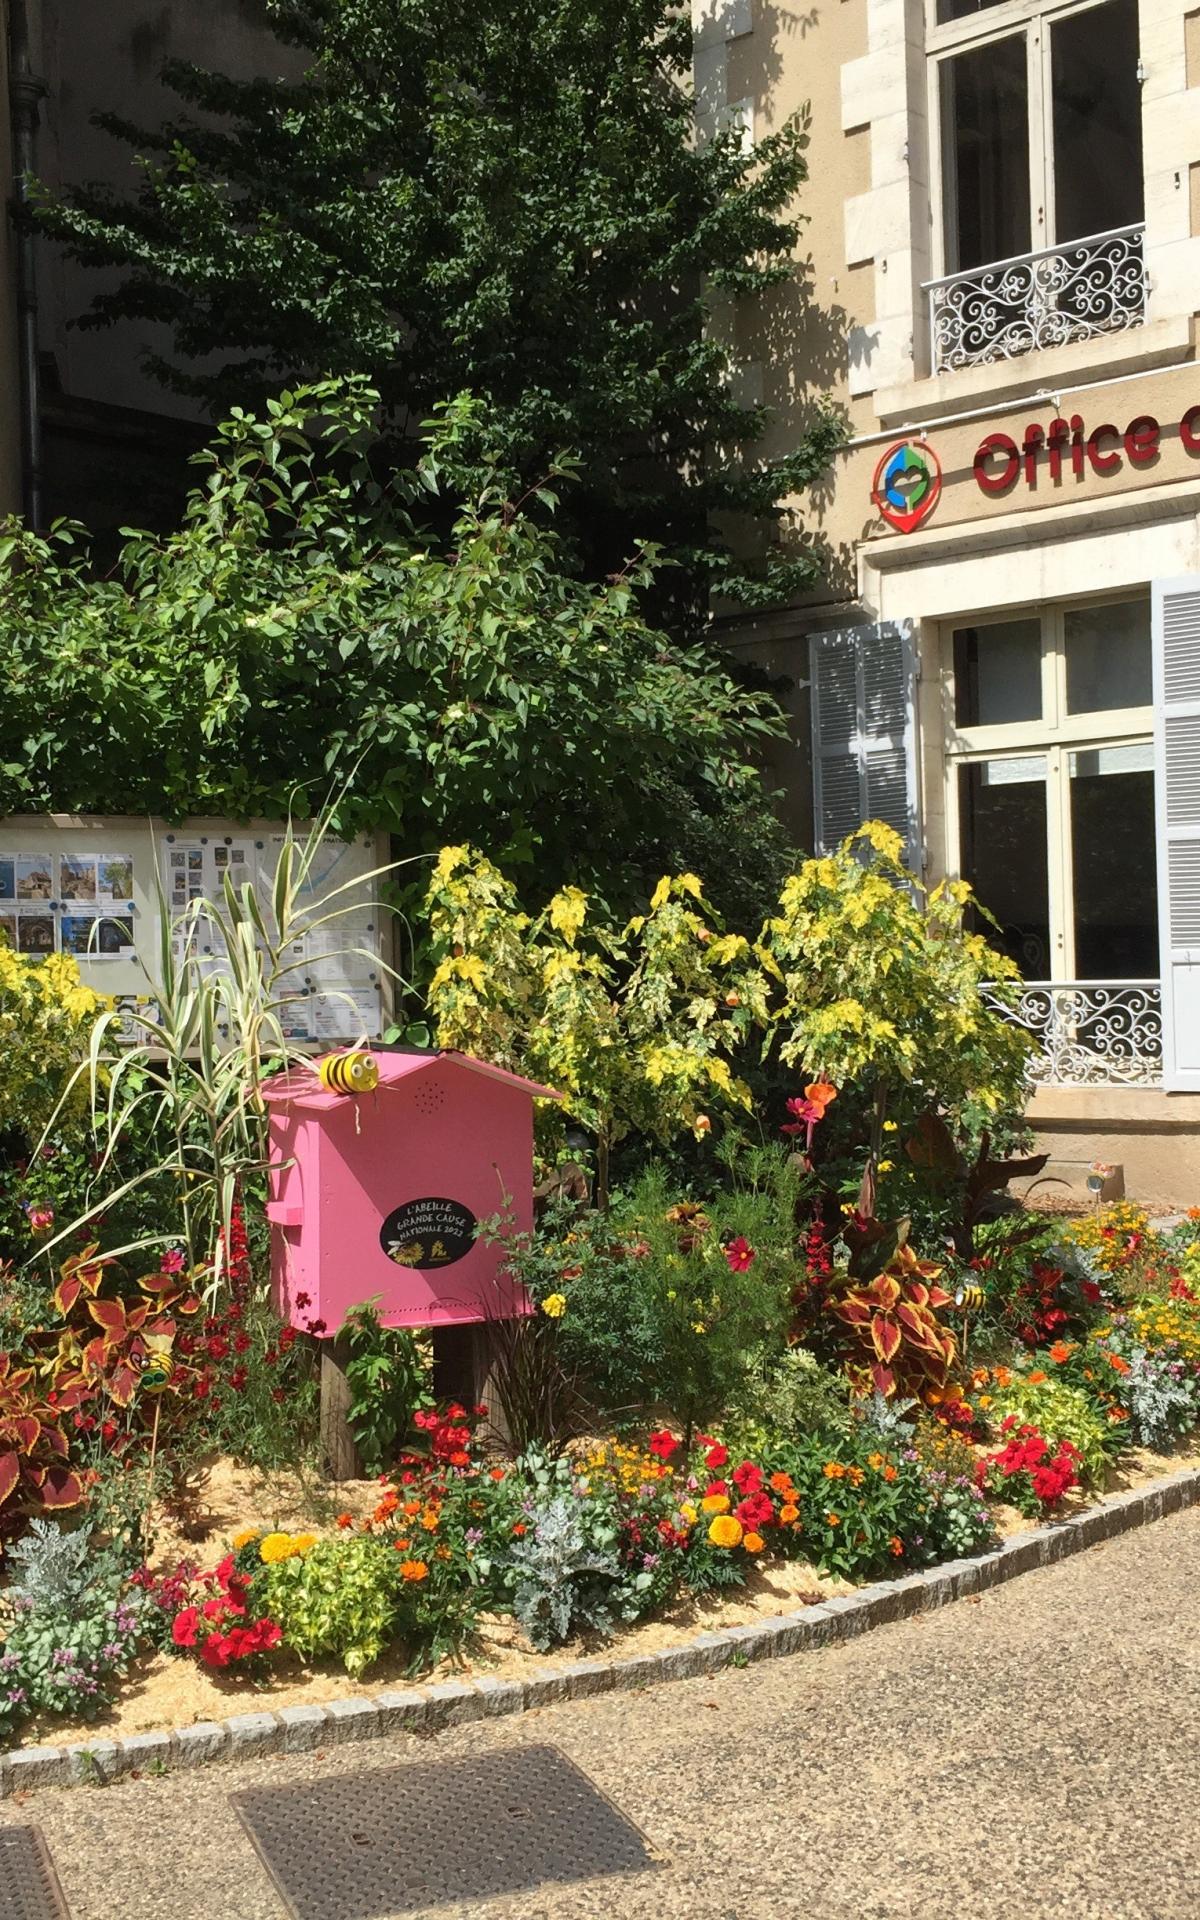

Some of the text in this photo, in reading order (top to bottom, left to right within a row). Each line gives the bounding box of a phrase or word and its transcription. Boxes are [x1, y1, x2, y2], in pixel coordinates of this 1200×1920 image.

[973, 414, 1160, 491] Office
[407, 1201, 453, 1215] L'ABEILLE
[397, 1213, 467, 1231] GRANDE CAUSE
[400, 1225, 464, 1241] NATIONALE 2022
